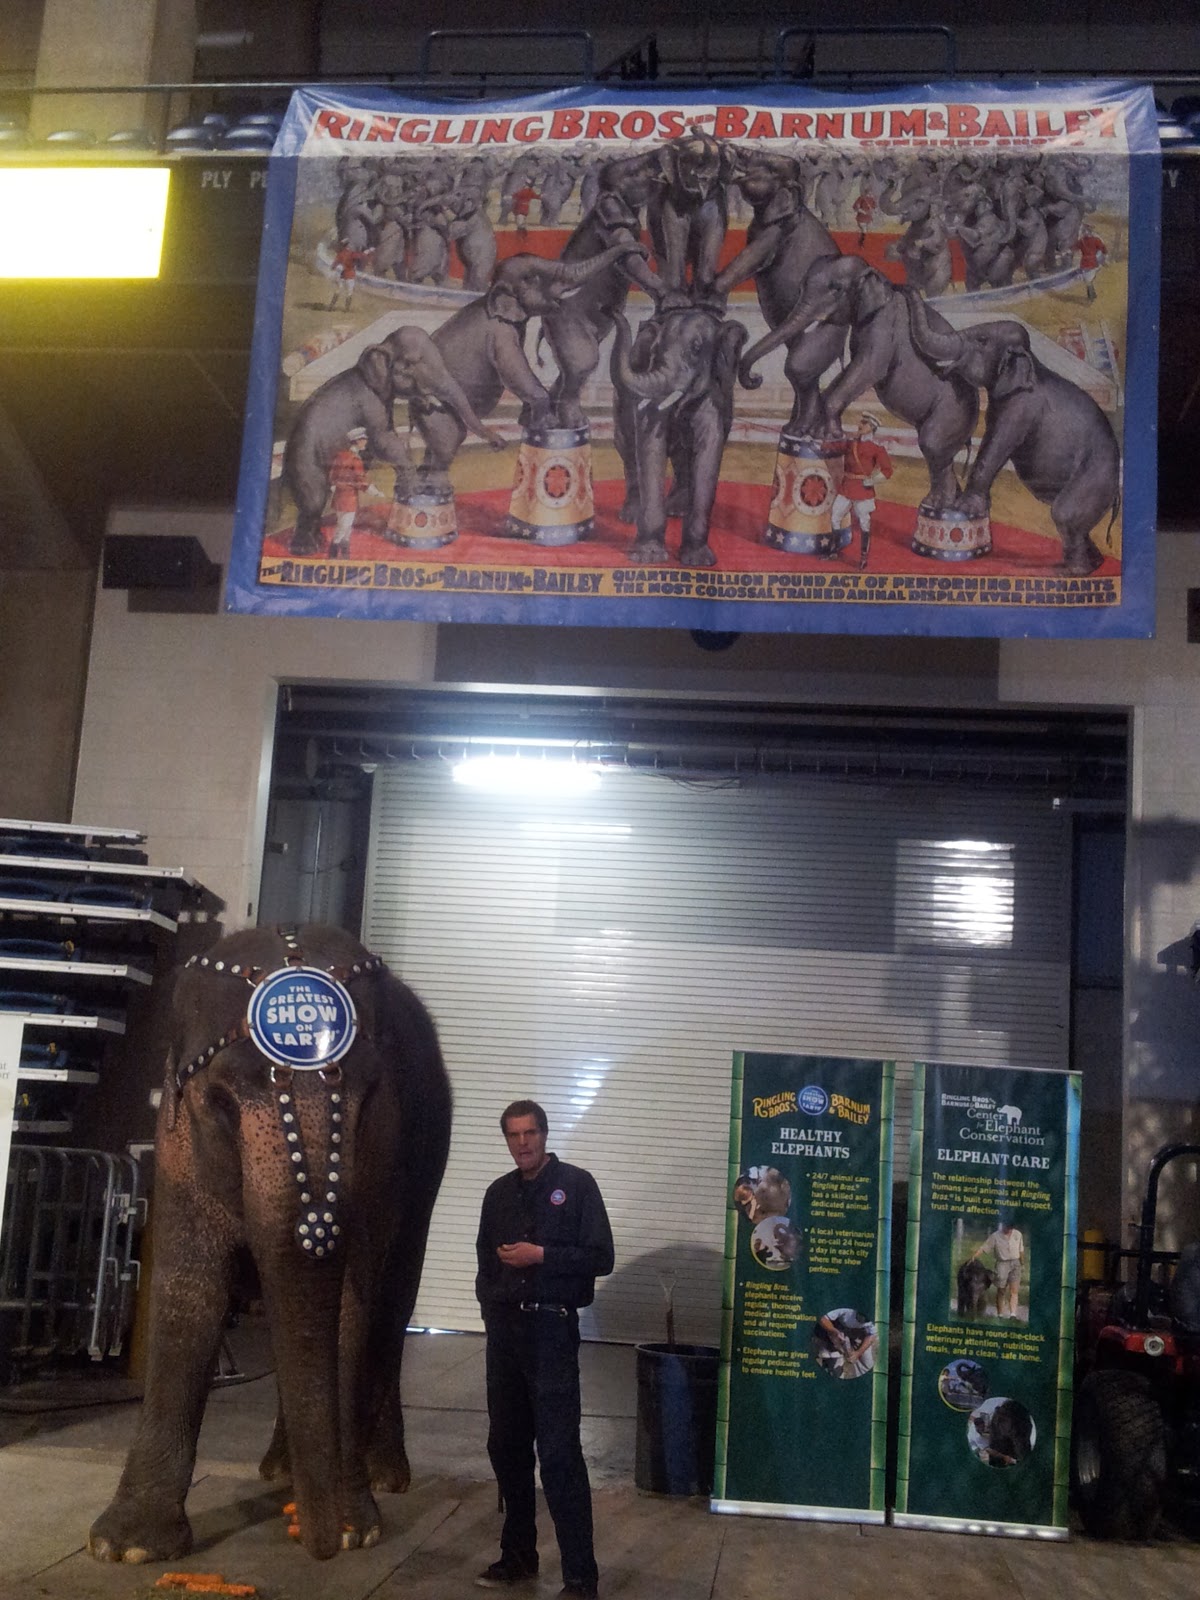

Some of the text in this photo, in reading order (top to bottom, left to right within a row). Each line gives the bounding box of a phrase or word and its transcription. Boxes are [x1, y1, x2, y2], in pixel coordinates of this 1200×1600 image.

[316, 109, 543, 144] RINGLING
[714, 106, 928, 139] BARNUM
[928, 111, 948, 131] &
[946, 104, 1118, 138] BAILEY
[859, 138, 990, 147] COMBINED
[201, 170, 232, 188] PLY
[281, 560, 371, 586] RINGLING
[443, 566, 525, 591] BARNUM
[532, 568, 604, 593] BAILEY
[768, 574, 827, 588] POUND
[828, 575, 861, 588] ACT
[865, 576, 888, 589] OF
[892, 576, 1012, 591] PERFORMING
[1015, 578, 1115, 592] ELEPHANTS
[614, 582, 1117, 604] THE MOST COLOSSAL TRAINED ANIMAL DISPLAY EVER PRESENTED
[289, 985, 311, 993] THE
[268, 993, 334, 1006] GREATEST
[266, 1004, 337, 1024] SHOW
[295, 1024, 313, 1032] ON
[830, 1093, 871, 1114] BARNUM
[941, 1093, 970, 1102] RINGLING
[753, 1091, 796, 1118] RINGLING
[837, 1105, 870, 1125] BAILEY
[967, 1108, 1004, 1120] Center
[985, 1119, 1041, 1136] Elephant
[780, 1127, 842, 1143] HEALTHY
[959, 1127, 1045, 1145] Conservation
[771, 1142, 850, 1159] ELEPHANTS
[937, 1149, 1050, 1169] ELEPHANT CARE
[830, 1174, 854, 1182] animal
[932, 1172, 1039, 1189] The relationship between the
[812, 1181, 839, 1191] Ringling
[931, 1182, 961, 1192] humans
[979, 1186, 1009, 1196] animals
[1021, 1189, 1051, 1201] Ringling
[811, 1200, 845, 1208] dedicated
[931, 1202, 948, 1210] trust
[950, 1204, 964, 1212] and
[963, 1194, 981, 1203] built
[994, 1199, 1021, 1207] mutual
[842, 1238, 853, 1246] 24
[815, 1247, 828, 1255] day
[746, 1281, 772, 1291] Ringling
[745, 1291, 777, 1300] elephants
[772, 1302, 801, 1312] thorough
[744, 1310, 817, 1321] medical examinations
[927, 1323, 964, 1334] Elephants
[965, 1327, 984, 1336] have
[926, 1334, 963, 1345] veterinary
[1003, 1342, 1039, 1352] nutritious
[743, 1346, 776, 1356] Elephants
[952, 1347, 967, 1355] and
[1001, 1351, 1017, 1360] safe
[767, 1359, 800, 1367] pedicures
[775, 1368, 800, 1378] healthy
